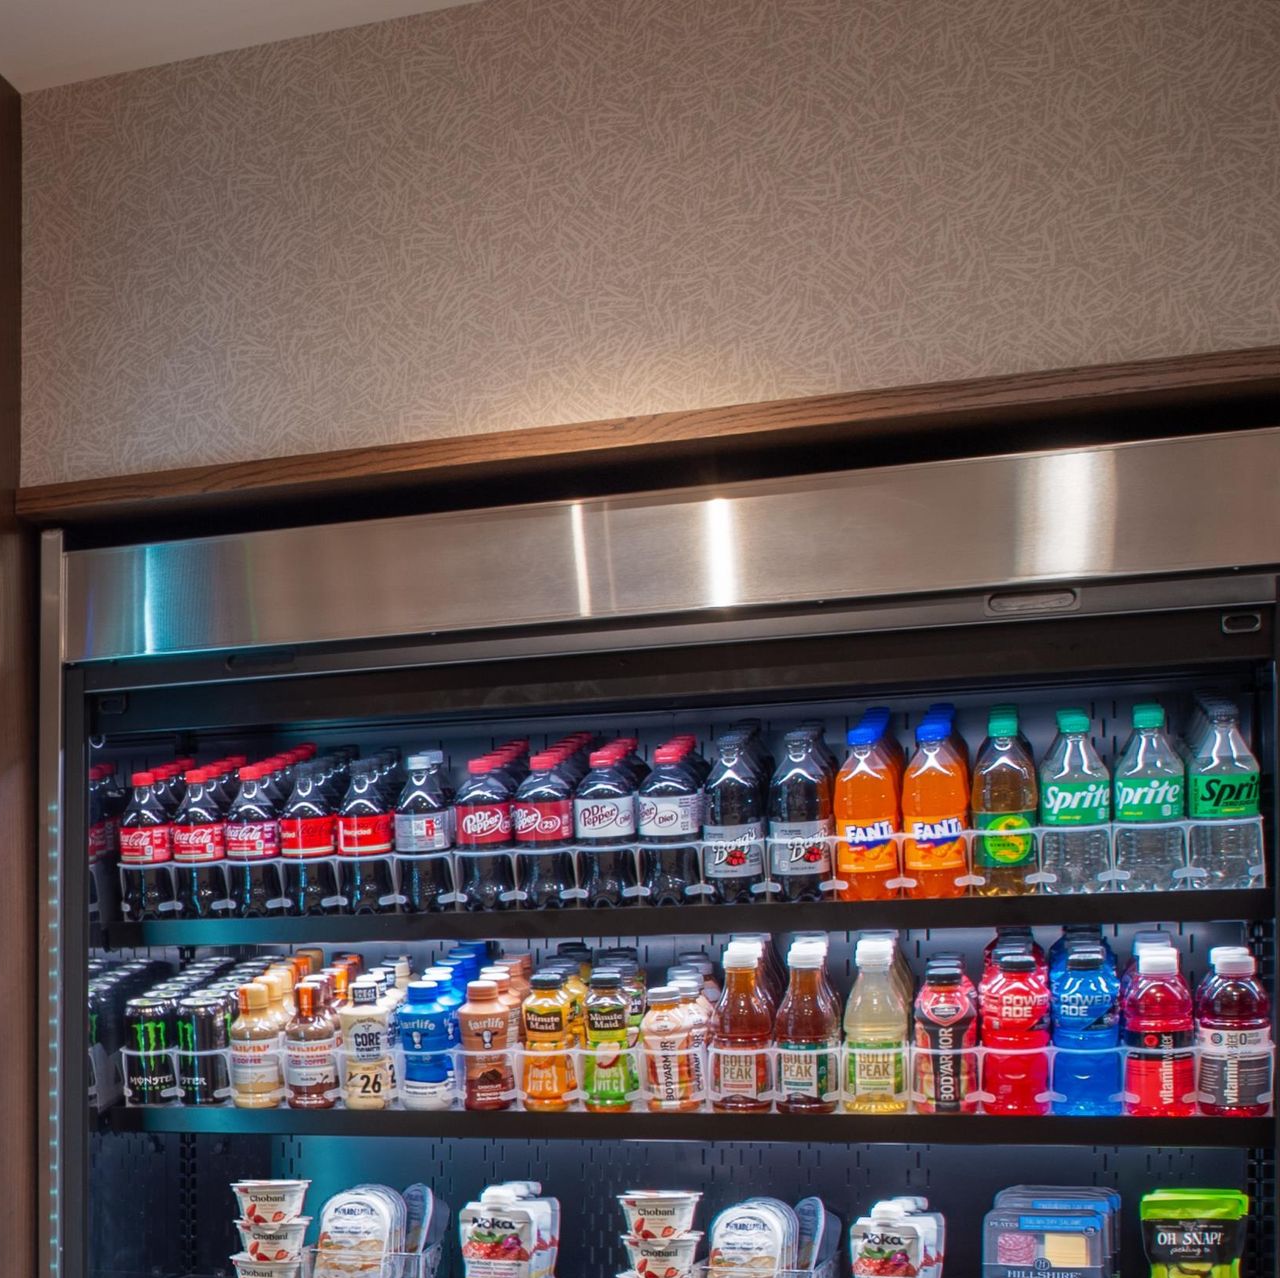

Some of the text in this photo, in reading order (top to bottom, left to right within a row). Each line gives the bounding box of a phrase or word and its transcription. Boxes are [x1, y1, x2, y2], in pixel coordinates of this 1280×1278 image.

[465, 813, 500, 834] Pepper
[583, 807, 616, 827] Pepper
[658, 813, 674, 825] Diet
[1002, 1006, 1033, 1018] ADE
[1060, 1005, 1089, 1017] ADE
[468, 1018, 505, 1031] fairlife
[527, 1013, 560, 1023] Minute
[530, 1021, 556, 1030] Maid
[354, 1031, 381, 1047] CORE
[660, 1040, 674, 1101] BODYARMR
[859, 1064, 890, 1077] PEAK
[940, 1027, 953, 1101] BODYARMOR
[1160, 1033, 1174, 1105] vitaminwter
[1224, 1033, 1238, 1104] vitaminwter
[723, 1067, 753, 1080] PEAK
[784, 1065, 813, 1077] PEAK
[249, 1194, 286, 1202] Chobani
[638, 1208, 676, 1216] Chobani
[252, 1232, 288, 1240] Chobani
[1158, 1231, 1222, 1245] OH SNAP!
[640, 1249, 679, 1257] Chobani
